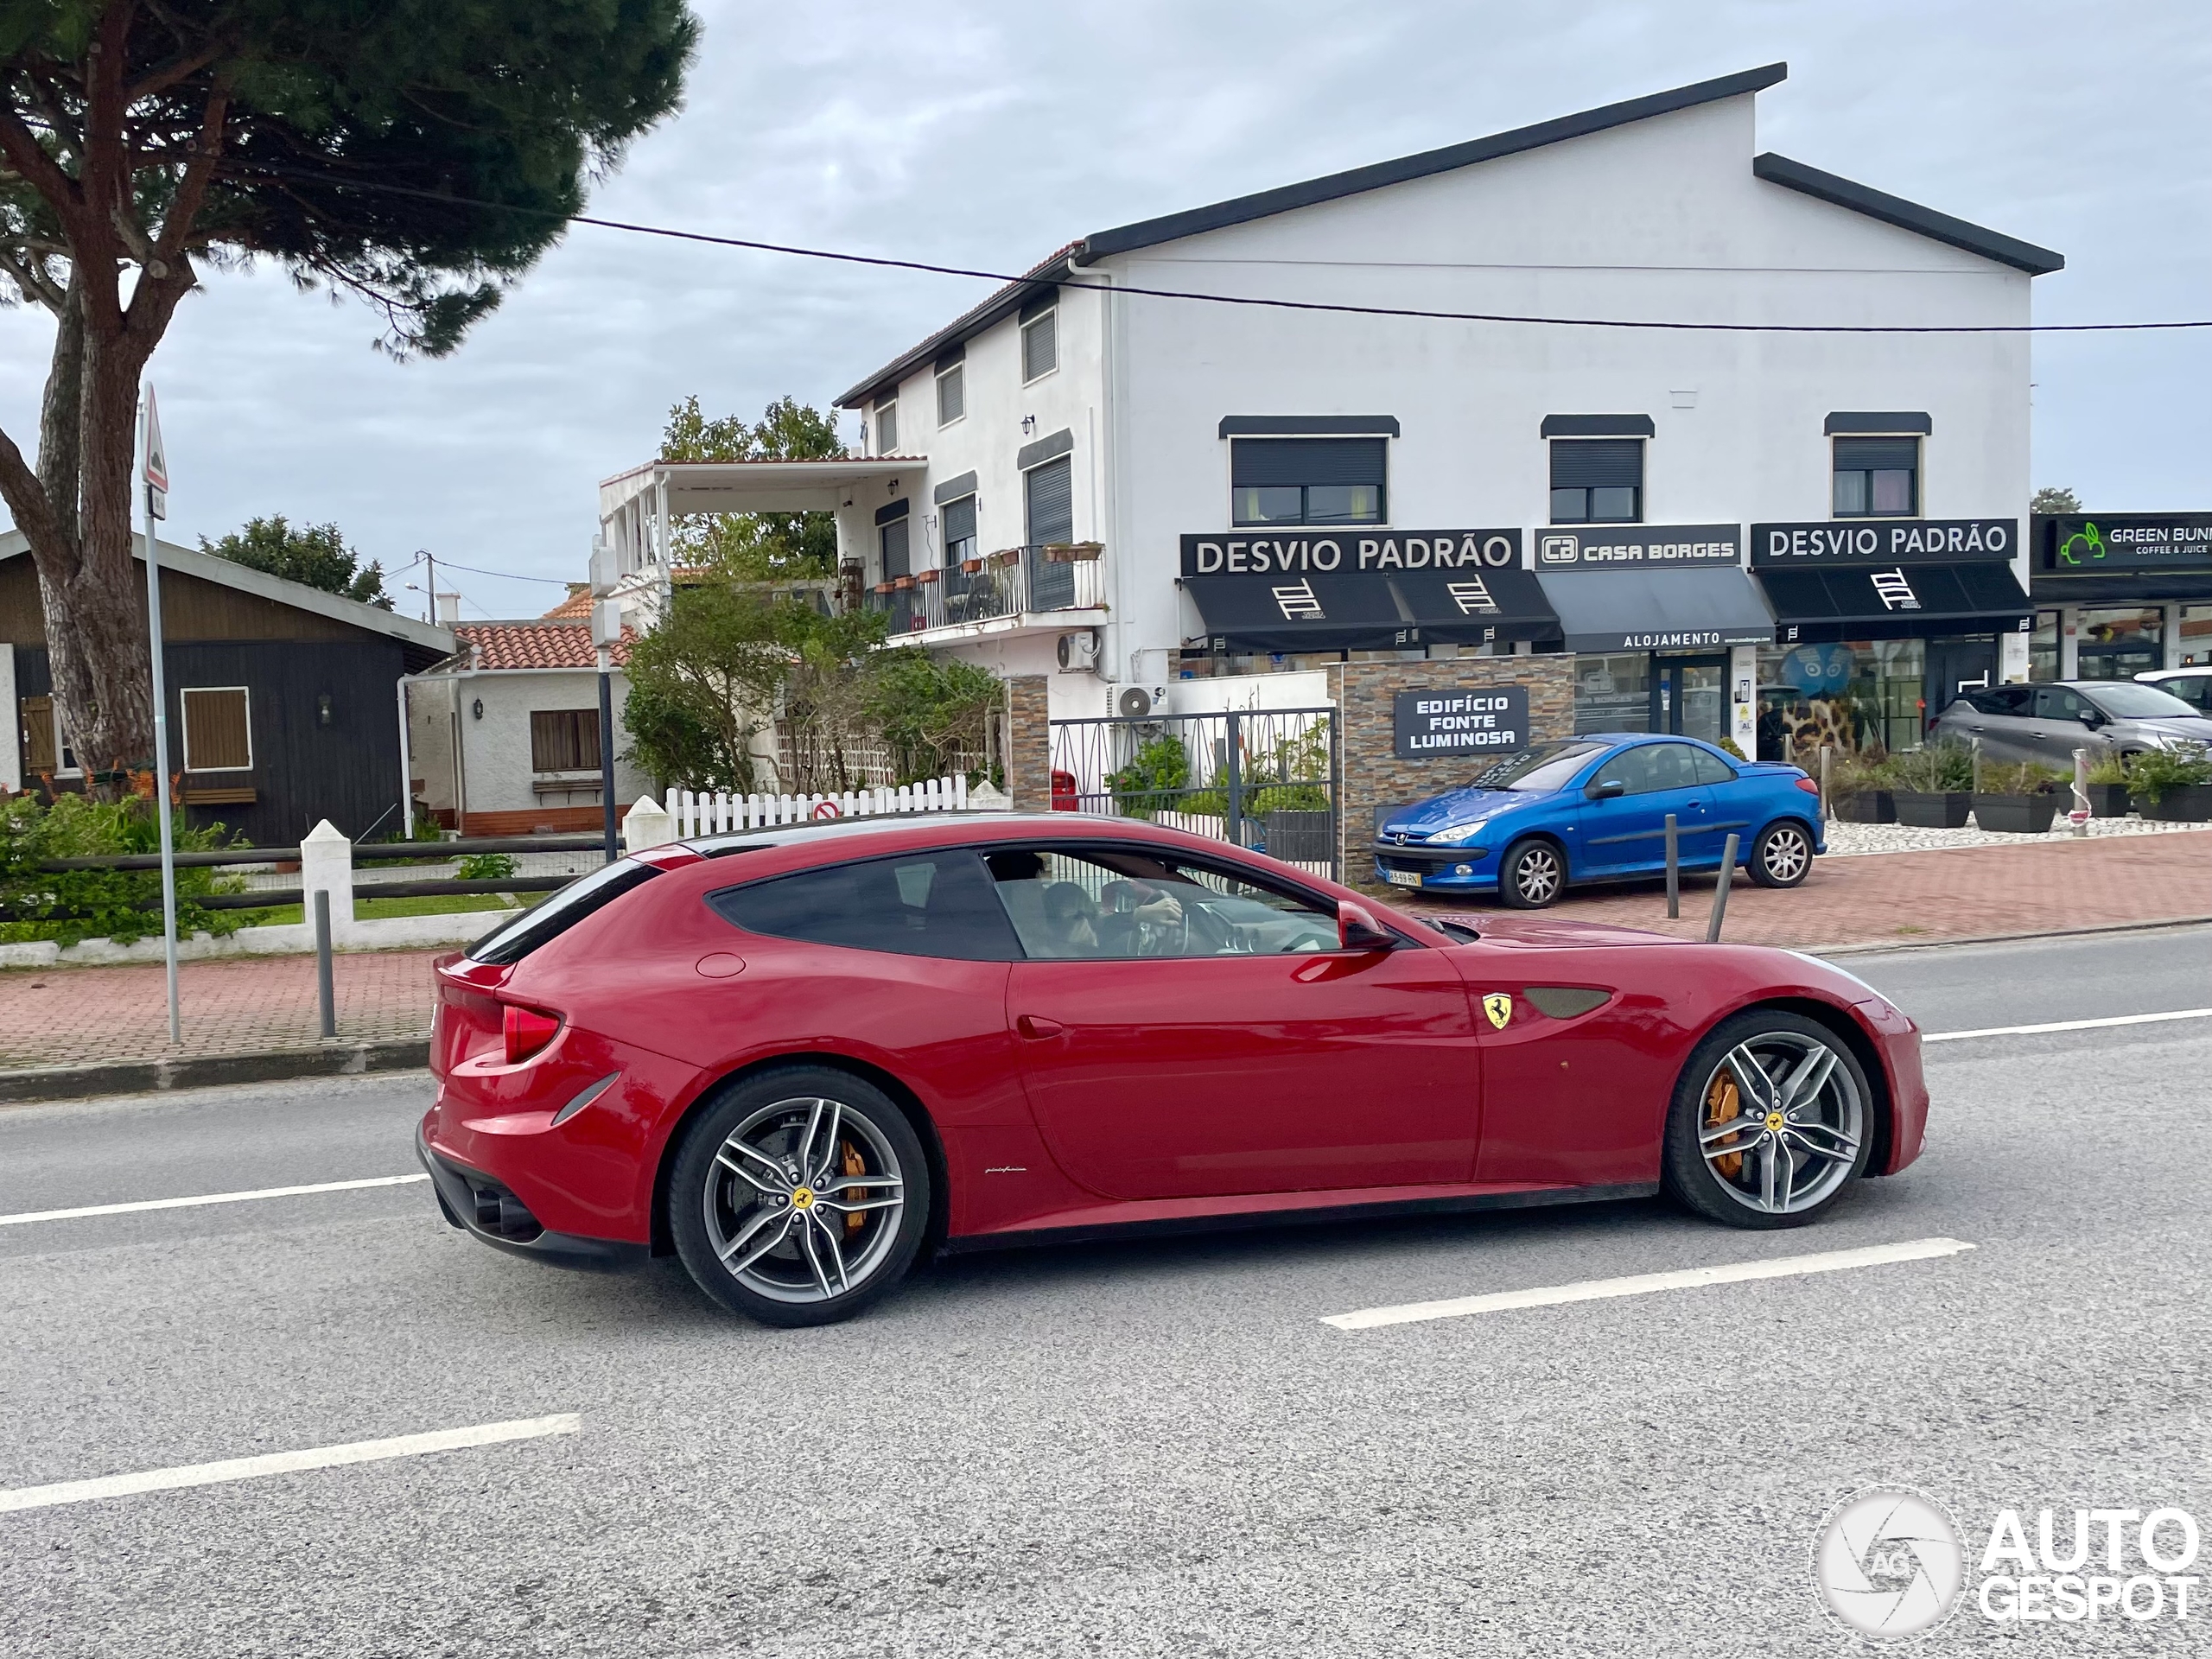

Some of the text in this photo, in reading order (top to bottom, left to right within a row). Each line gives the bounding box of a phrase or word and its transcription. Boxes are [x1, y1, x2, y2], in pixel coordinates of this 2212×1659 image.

[1770, 523, 2007, 556] DESVIO PADRÃO
[2110, 528, 2169, 543] GREEN
[1197, 532, 1512, 573] DESVIO PADRÃO
[1583, 542, 1736, 562] CASA BORGES
[2136, 544, 2209, 555] COFFEE & JUICE
[1624, 632, 1720, 648] ALOJAMENTO
[1416, 694, 1509, 715] EDIFÍCIO
[1429, 715, 1496, 730] FONTE
[1410, 730, 1516, 749] LUMINOSA
